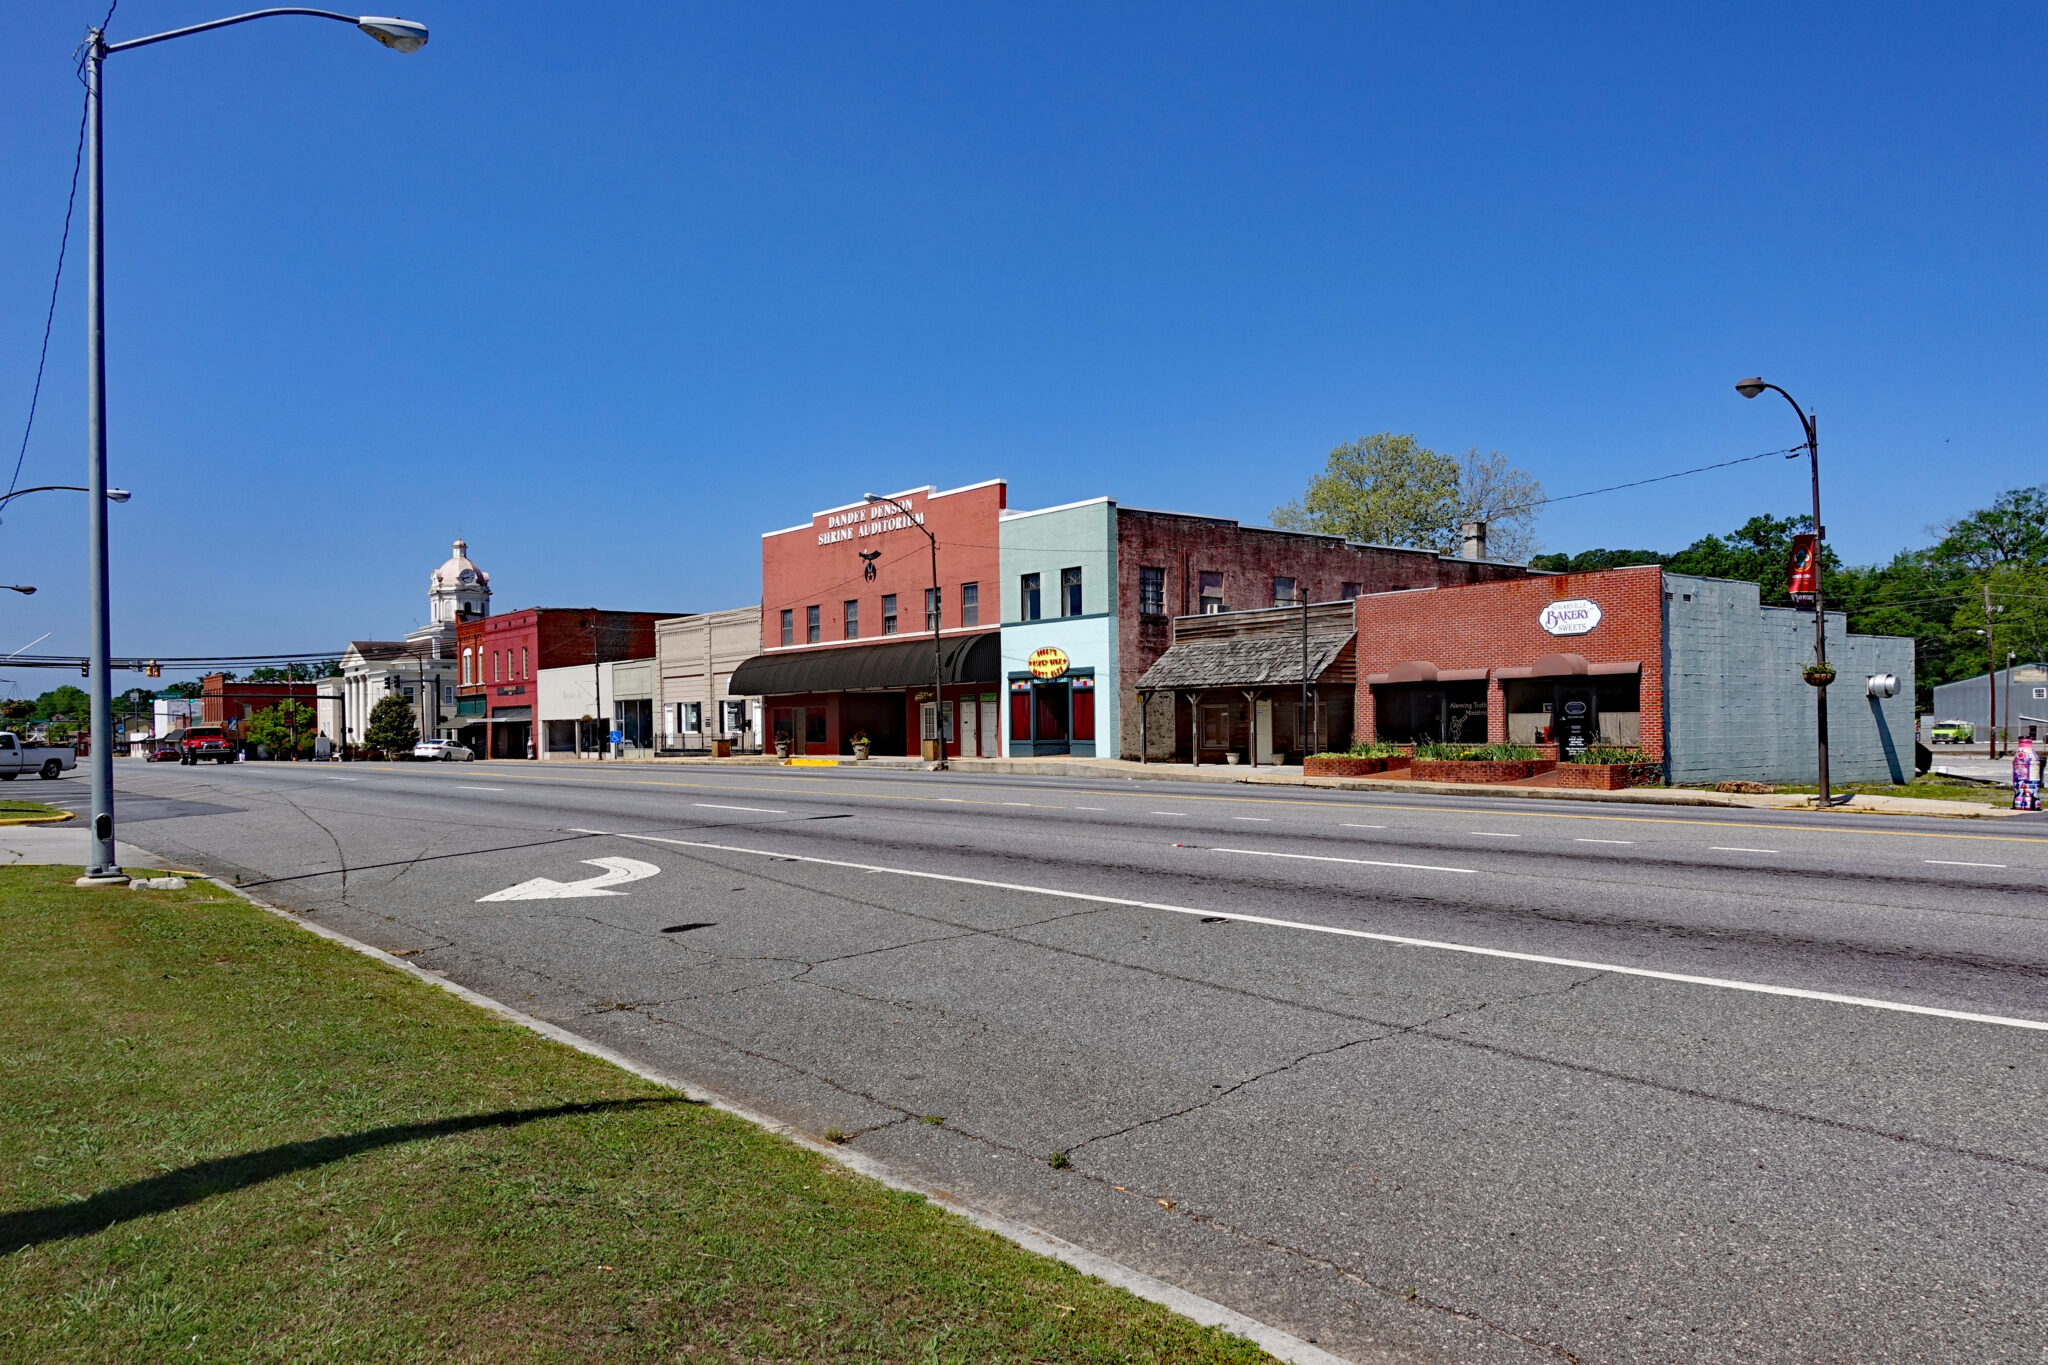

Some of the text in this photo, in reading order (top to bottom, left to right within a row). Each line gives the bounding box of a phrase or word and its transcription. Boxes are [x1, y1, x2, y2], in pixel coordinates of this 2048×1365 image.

[829, 499, 912, 528] DANDEE DENSON
[818, 512, 924, 545] SHRINE AUDITORIUM
[1552, 602, 1587, 610] SUGARVILLE
[1545, 609, 1588, 629] BAKERY
[1558, 624, 1586, 632] SWEETS
